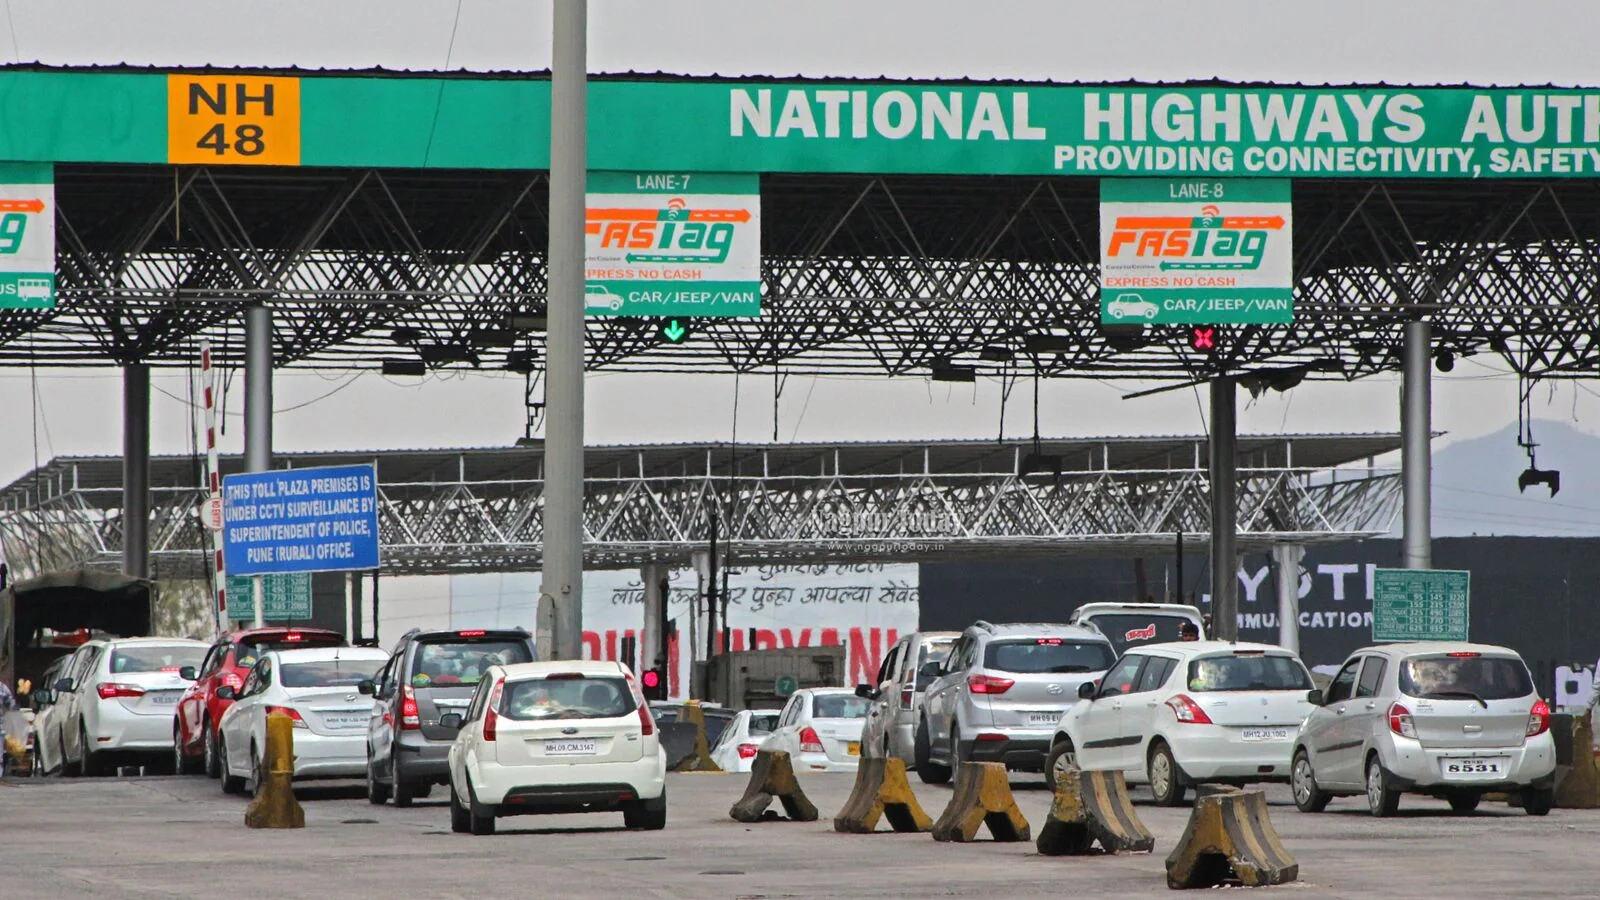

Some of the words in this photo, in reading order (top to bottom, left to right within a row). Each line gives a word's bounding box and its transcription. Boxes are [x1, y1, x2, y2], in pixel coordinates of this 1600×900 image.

[189, 83, 274, 115] NH
[729, 89, 1046, 141] NATIONAL
[1083, 93, 1426, 143] HIGHWAYS
[197, 123, 265, 155] 48
[1054, 145, 1234, 172] PROVIDING
[1243, 147, 1481, 178] CONNECTIVITY,
[636, 175, 691, 190] LANE-7
[1169, 183, 1224, 198] LANE-8
[587, 269, 634, 279] PRESS
[639, 269, 658, 279] NO
[663, 269, 702, 279] CASH
[1105, 277, 1168, 287] EXPRESS
[1173, 277, 1193, 287] NO
[1197, 276, 1236, 286] CASH
[628, 292, 754, 305] CAR/JEEP/VAN
[1163, 299, 1288, 312] CAR/JEEP/VAN
[228, 485, 250, 499] THIS
[252, 482, 276, 498] TOLL
[278, 480, 308, 496] PLAZA
[311, 478, 359, 495] PREMISES
[361, 476, 370, 491] IS
[225, 505, 257, 522] UNDER
[259, 504, 285, 519] CCTV
[287, 499, 360, 518] SURVEILLANCE
[361, 497, 374, 513] BY
[230, 523, 316, 543] SUPERINTENDENT
[318, 522, 331, 538] OF
[333, 520, 371, 537] POLICE,
[248, 548, 273, 563] PUNE
[275, 545, 315, 562] (RURAL)
[317, 543, 354, 560] OFFICE.
[1448, 764, 1498, 773] 8531
